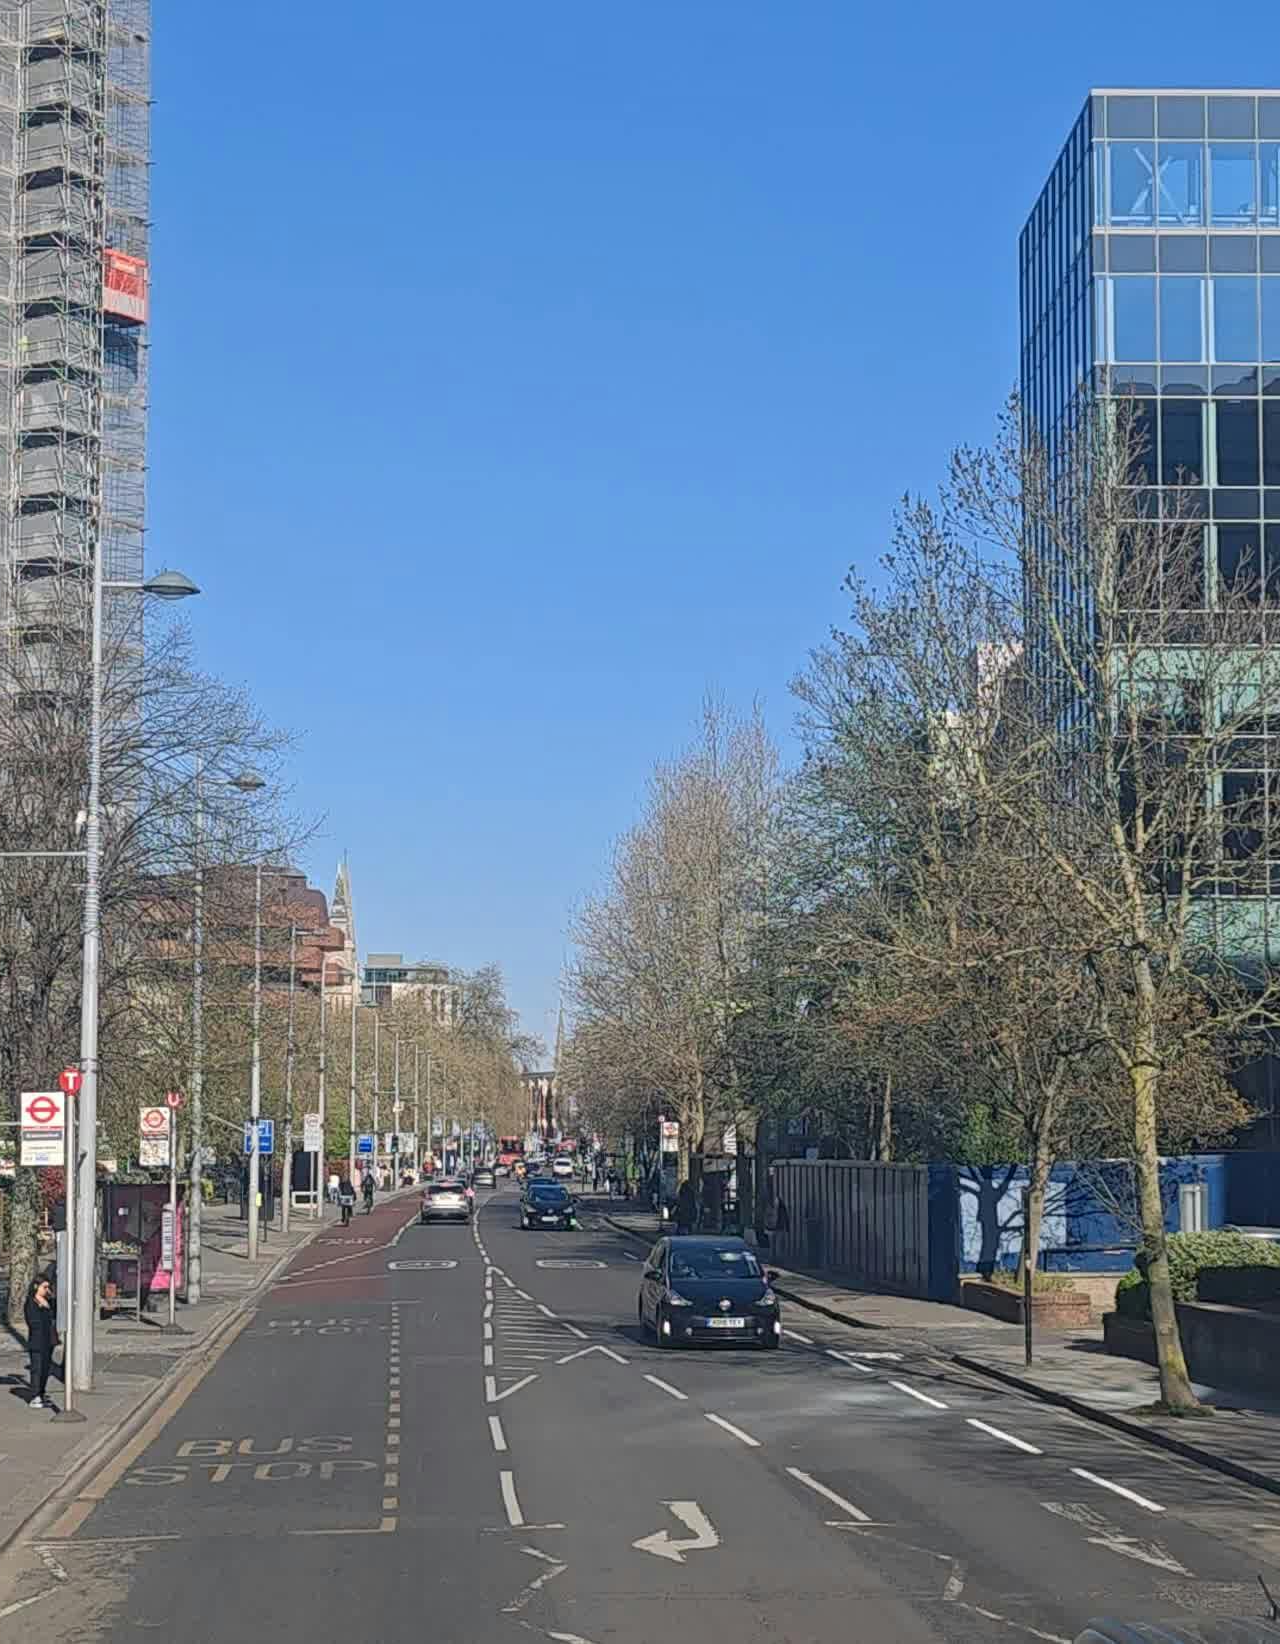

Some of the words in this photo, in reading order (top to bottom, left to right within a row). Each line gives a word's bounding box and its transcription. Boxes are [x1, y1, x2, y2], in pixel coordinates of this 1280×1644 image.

[64, 1072, 78, 1089] T
[167, 1090, 180, 1106] U
[176, 1435, 353, 1457] BUS
[123, 1459, 380, 1486] STOP
